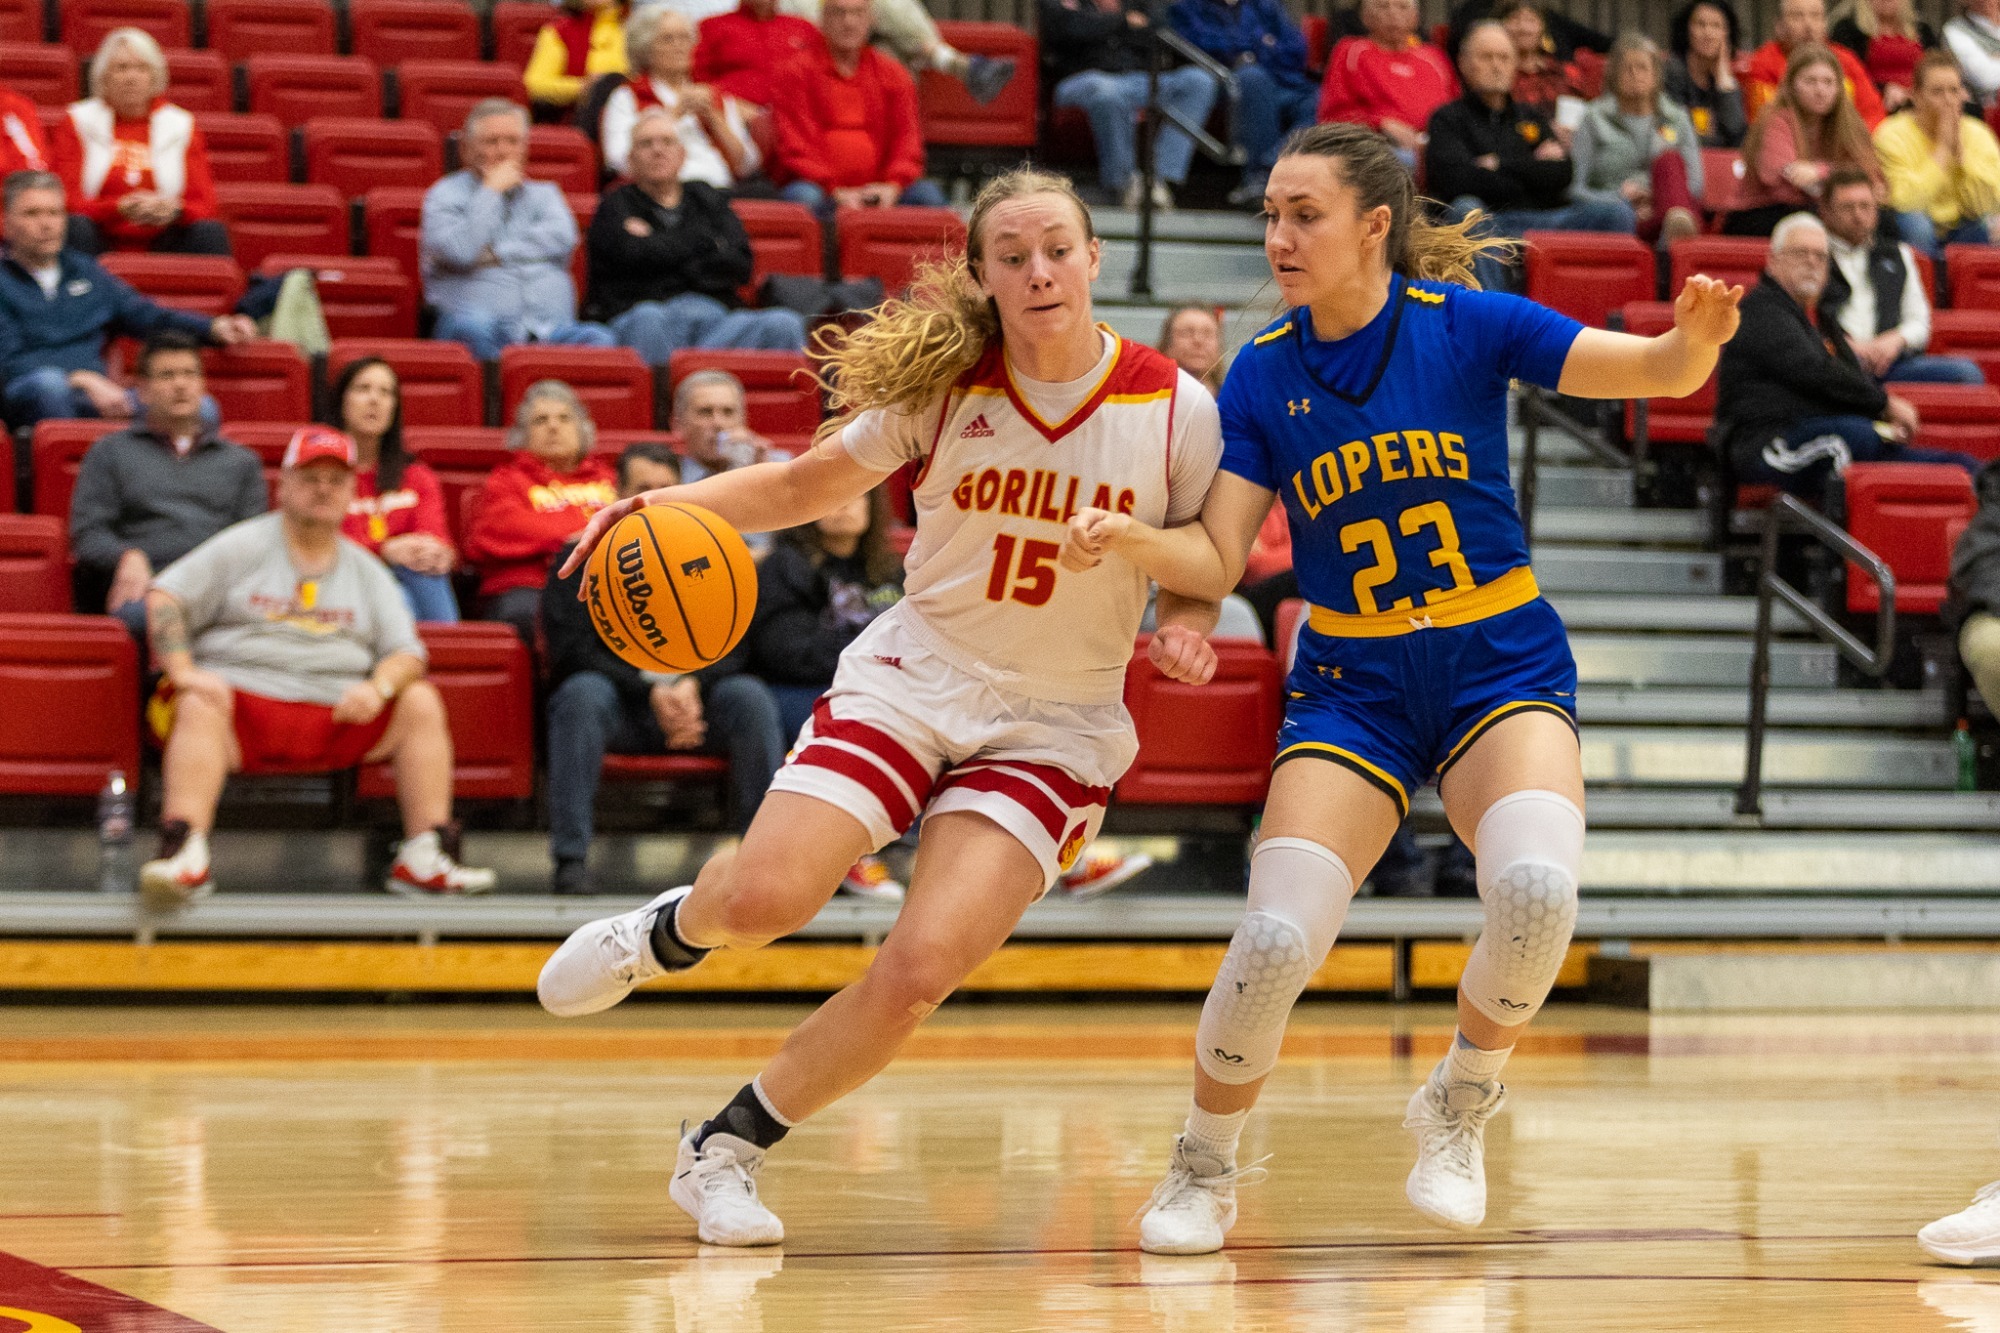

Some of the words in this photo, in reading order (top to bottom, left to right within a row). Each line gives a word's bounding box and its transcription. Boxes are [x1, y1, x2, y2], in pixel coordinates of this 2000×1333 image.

[960, 428, 995, 438] adidas
[952, 466, 1136, 524] GORILLAS
[1292, 430, 1469, 521] LOPERS
[616, 537, 668, 649] Wilson
[985, 532, 1061, 609] 15
[1339, 501, 1477, 616] 23
[589, 574, 627, 652] NCAA
